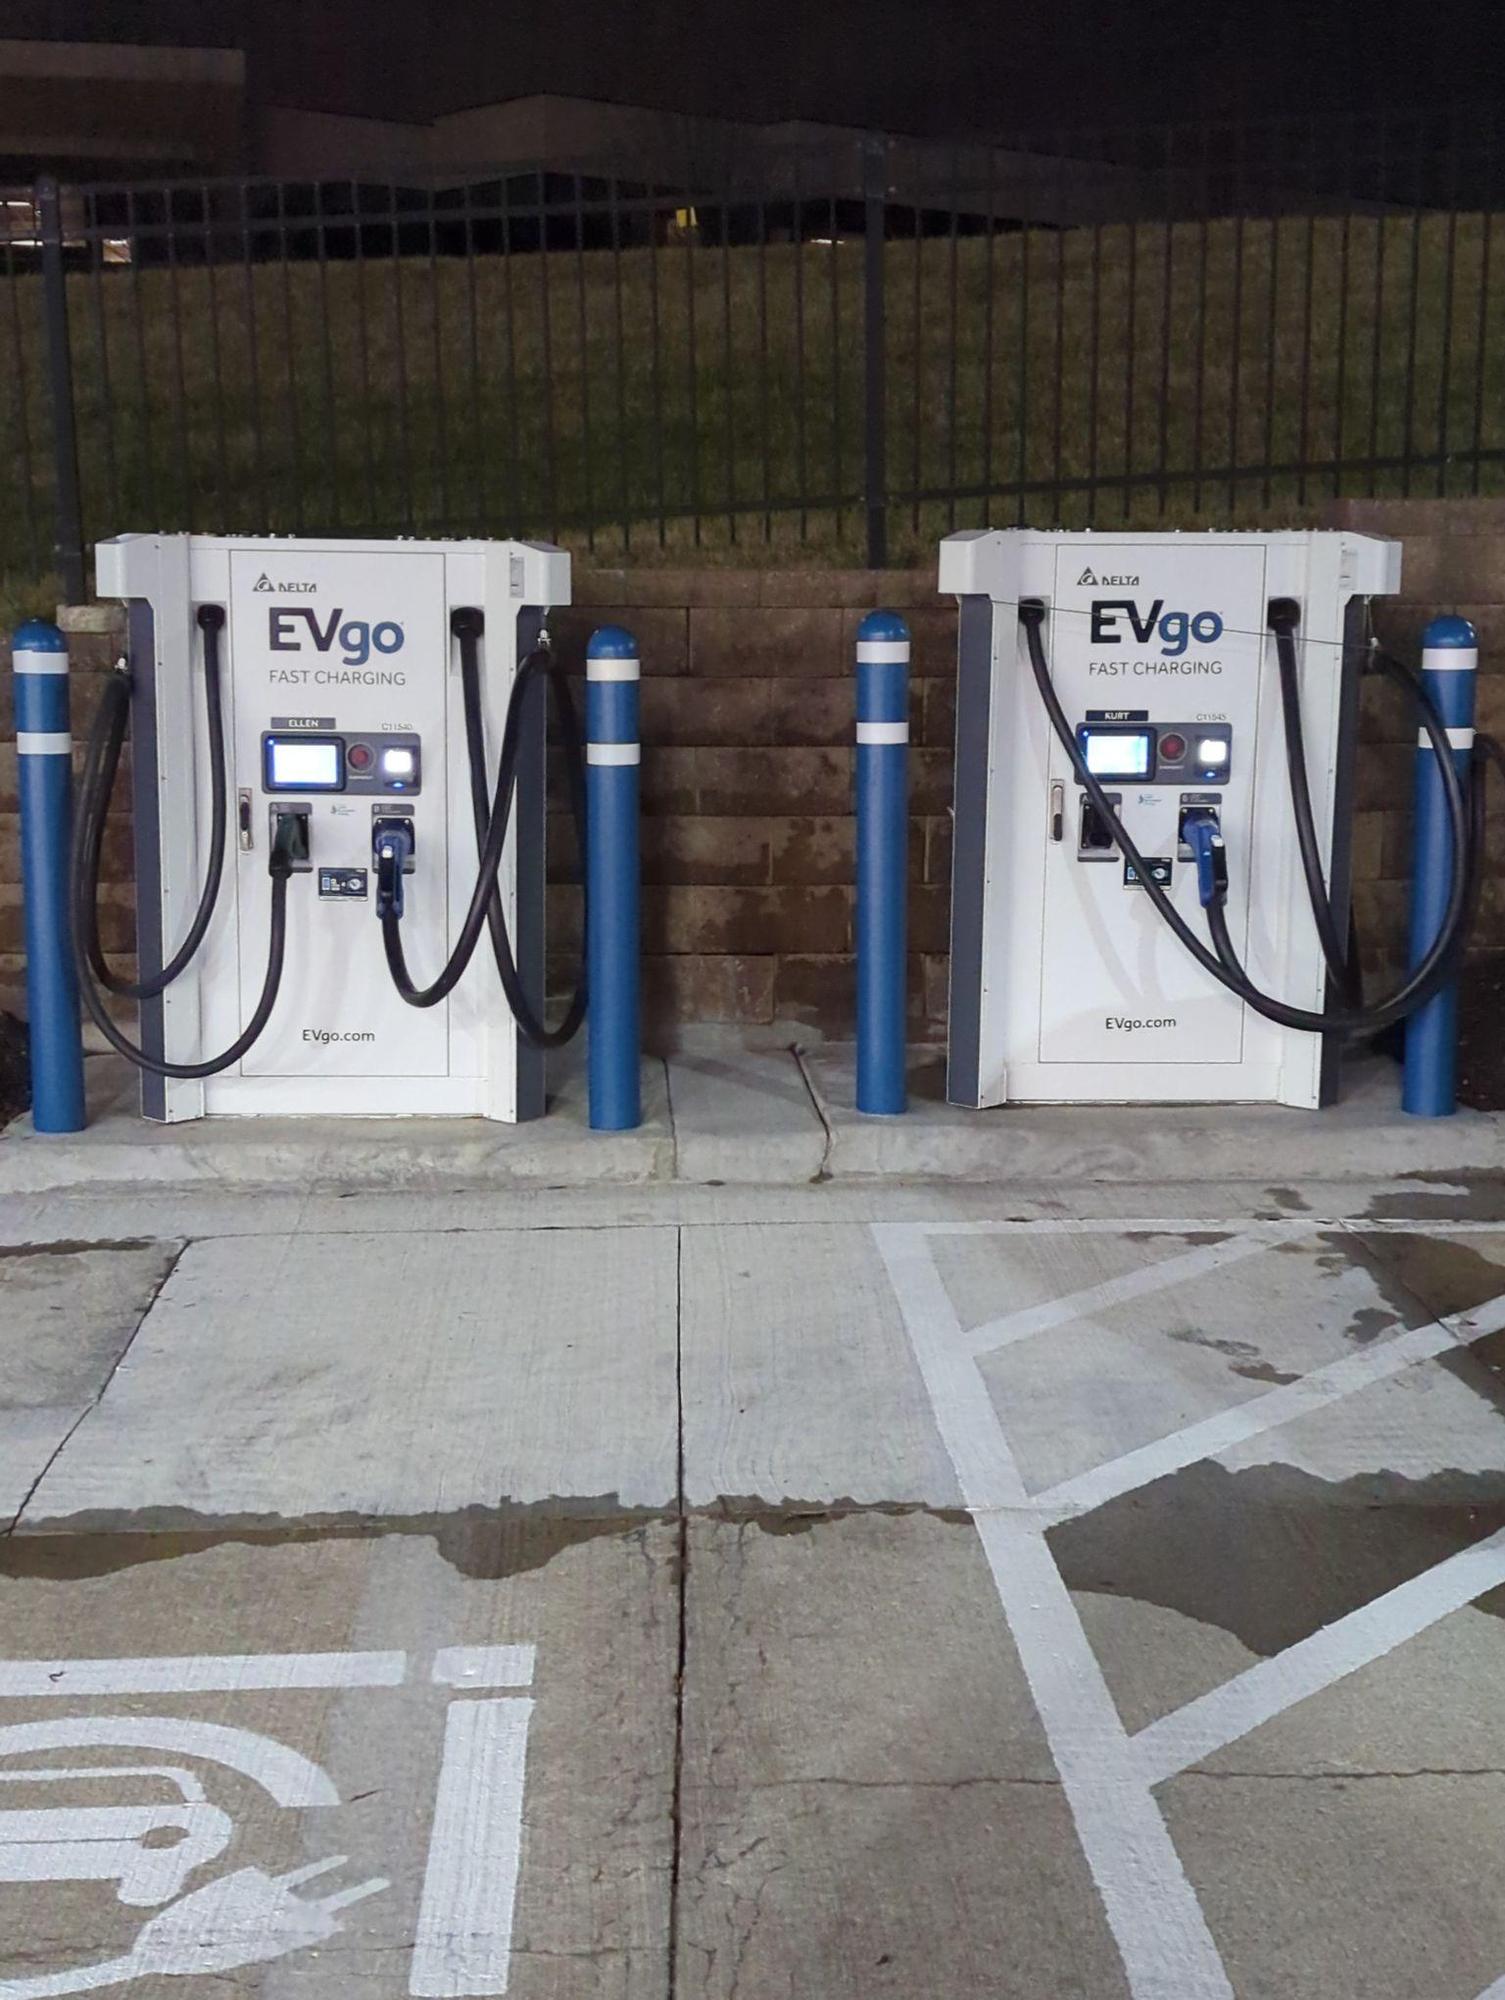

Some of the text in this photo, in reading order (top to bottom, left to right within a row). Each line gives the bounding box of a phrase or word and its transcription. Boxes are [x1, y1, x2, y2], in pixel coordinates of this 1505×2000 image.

[279, 583, 317, 593] DELTA
[1102, 576, 1140, 586] DELTA
[1091, 599, 1223, 657] EVgo
[269, 607, 405, 666] EVgo
[1089, 661, 1223, 676] FAST CHARGING
[269, 670, 406, 686] FAST CHARGING
[288, 719, 319, 728] ELLEN
[1104, 712, 1130, 720] KURT
[1105, 1017, 1177, 1032] EVgo.com
[302, 1029, 376, 1045] EVgo.com
